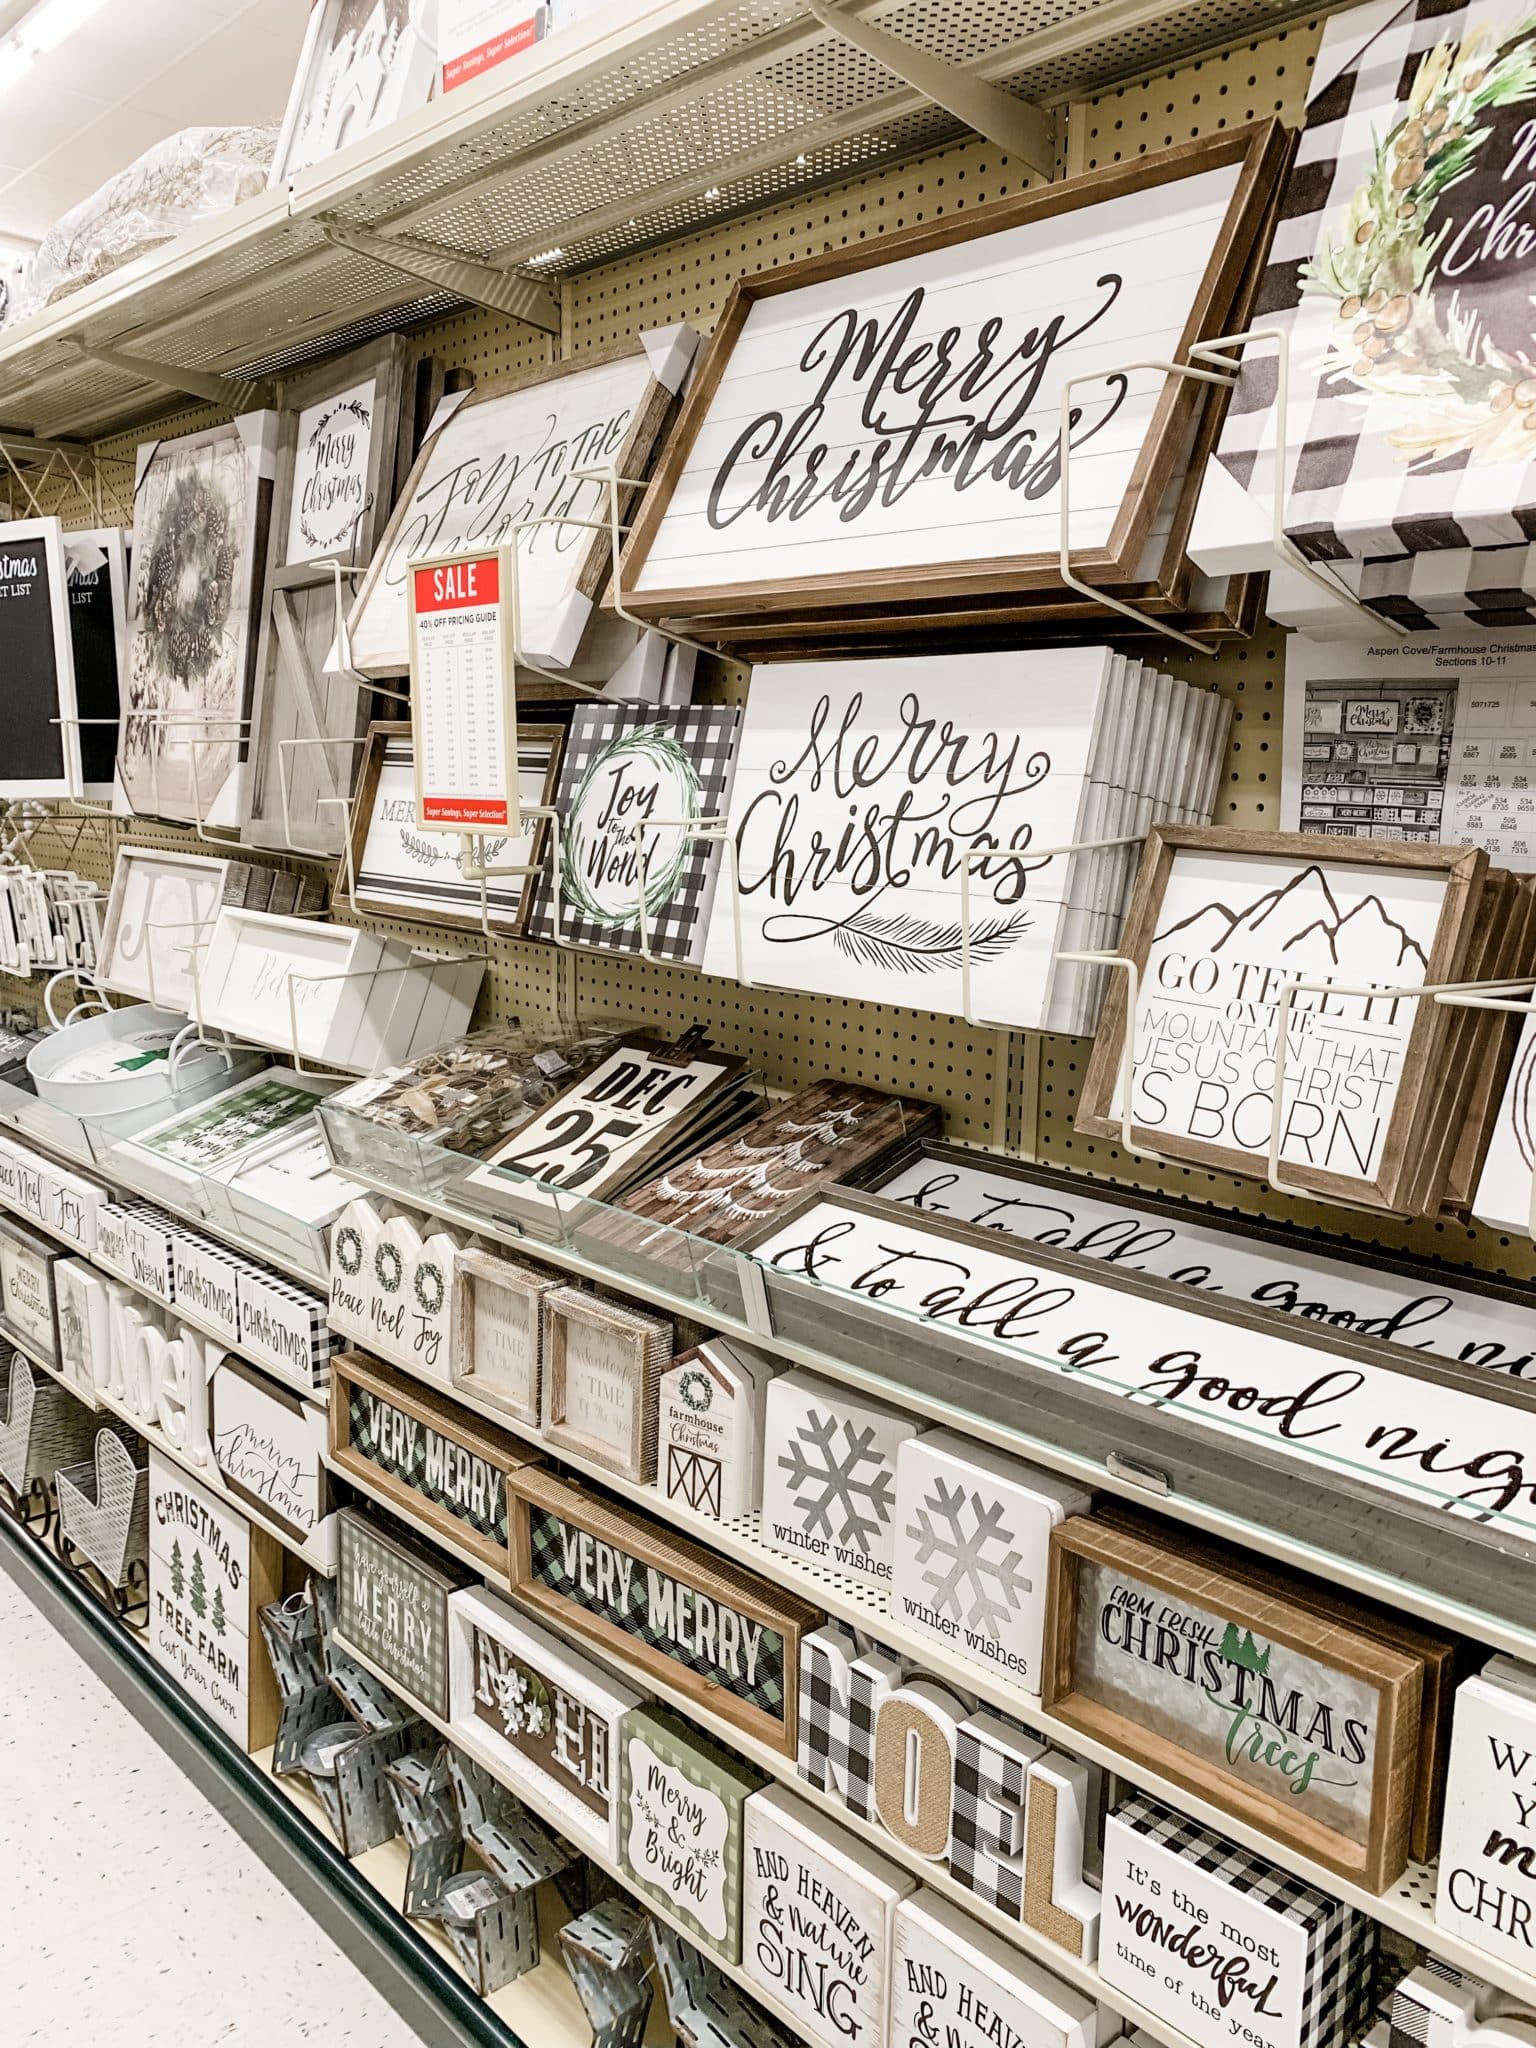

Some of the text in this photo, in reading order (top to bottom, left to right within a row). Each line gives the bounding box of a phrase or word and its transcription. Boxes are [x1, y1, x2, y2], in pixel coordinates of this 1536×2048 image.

[799, 273, 1122, 435] Merry
[315, 433, 355, 470] Merry
[706, 373, 1127, 530] Christmas
[301, 471, 362, 514] Christmas
[0, 555, 37, 579] tmas
[11, 583, 31, 596] LIST
[72, 592, 93, 604] LIST
[434, 563, 477, 602] SALE
[434, 616, 446, 628] OFF
[448, 614, 474, 627] PRICING
[476, 611, 497, 623] GUIDE
[1367, 646, 1399, 656] Aspen
[1402, 644, 1487, 656] Cove/Farmhouse
[1435, 656, 1506, 667] Sections 10-11
[598, 761, 660, 841] Joy
[770, 692, 1051, 837] Merry
[736, 790, 1053, 906] Christmas
[1158, 952, 1220, 995] GO
[1232, 963, 1345, 1017] TELL
[1133, 1036, 1394, 1114] JESUS CHRIST
[1143, 1008, 1400, 1078] MOUNTAIN THAT
[582, 1061, 696, 1117] DEC
[490, 1108, 641, 1192] 25
[1187, 1081, 1381, 1176] BORN
[52, 1187, 86, 1240] Joy
[332, 1276, 365, 1316] Peace
[371, 1296, 404, 1340] Noel
[412, 1312, 443, 1365] Joy
[669, 1406, 724, 1434] farmhouse
[669, 1422, 719, 1454] Christmas
[368, 1396, 501, 1526] VERY MERRY
[155, 1491, 243, 1590] CHRISTMAS
[353, 1543, 377, 1573] have
[377, 1568, 419, 1611] yourself
[773, 1522, 893, 1581] winter wishes
[156, 1590, 240, 1692] TREE FARM
[353, 1569, 432, 1661] MERRY
[559, 1521, 764, 1687] VERY MERRY
[903, 1597, 1027, 1676] winter wishes
[1109, 1584, 1219, 1649] FARM FRESH
[159, 1629, 238, 1720] Cut Your Own
[381, 1628, 426, 1682] Christmas
[1101, 1603, 1370, 1767] CHRISTMAS
[647, 1764, 707, 1837] Merry
[667, 1817, 686, 1850] &
[797, 1630, 1100, 1968] NOEL
[645, 1828, 708, 1903] Bright
[753, 1846, 876, 1961] AND HEAVEN
[763, 1884, 785, 1929] &
[1126, 1859, 1280, 1968] It's the most
[757, 1918, 863, 2041] SING
[904, 1958, 948, 2000] AND
[1116, 1941, 1156, 1978] time
[1164, 1975, 1184, 1996] of
[1190, 1990, 1221, 2021] the
